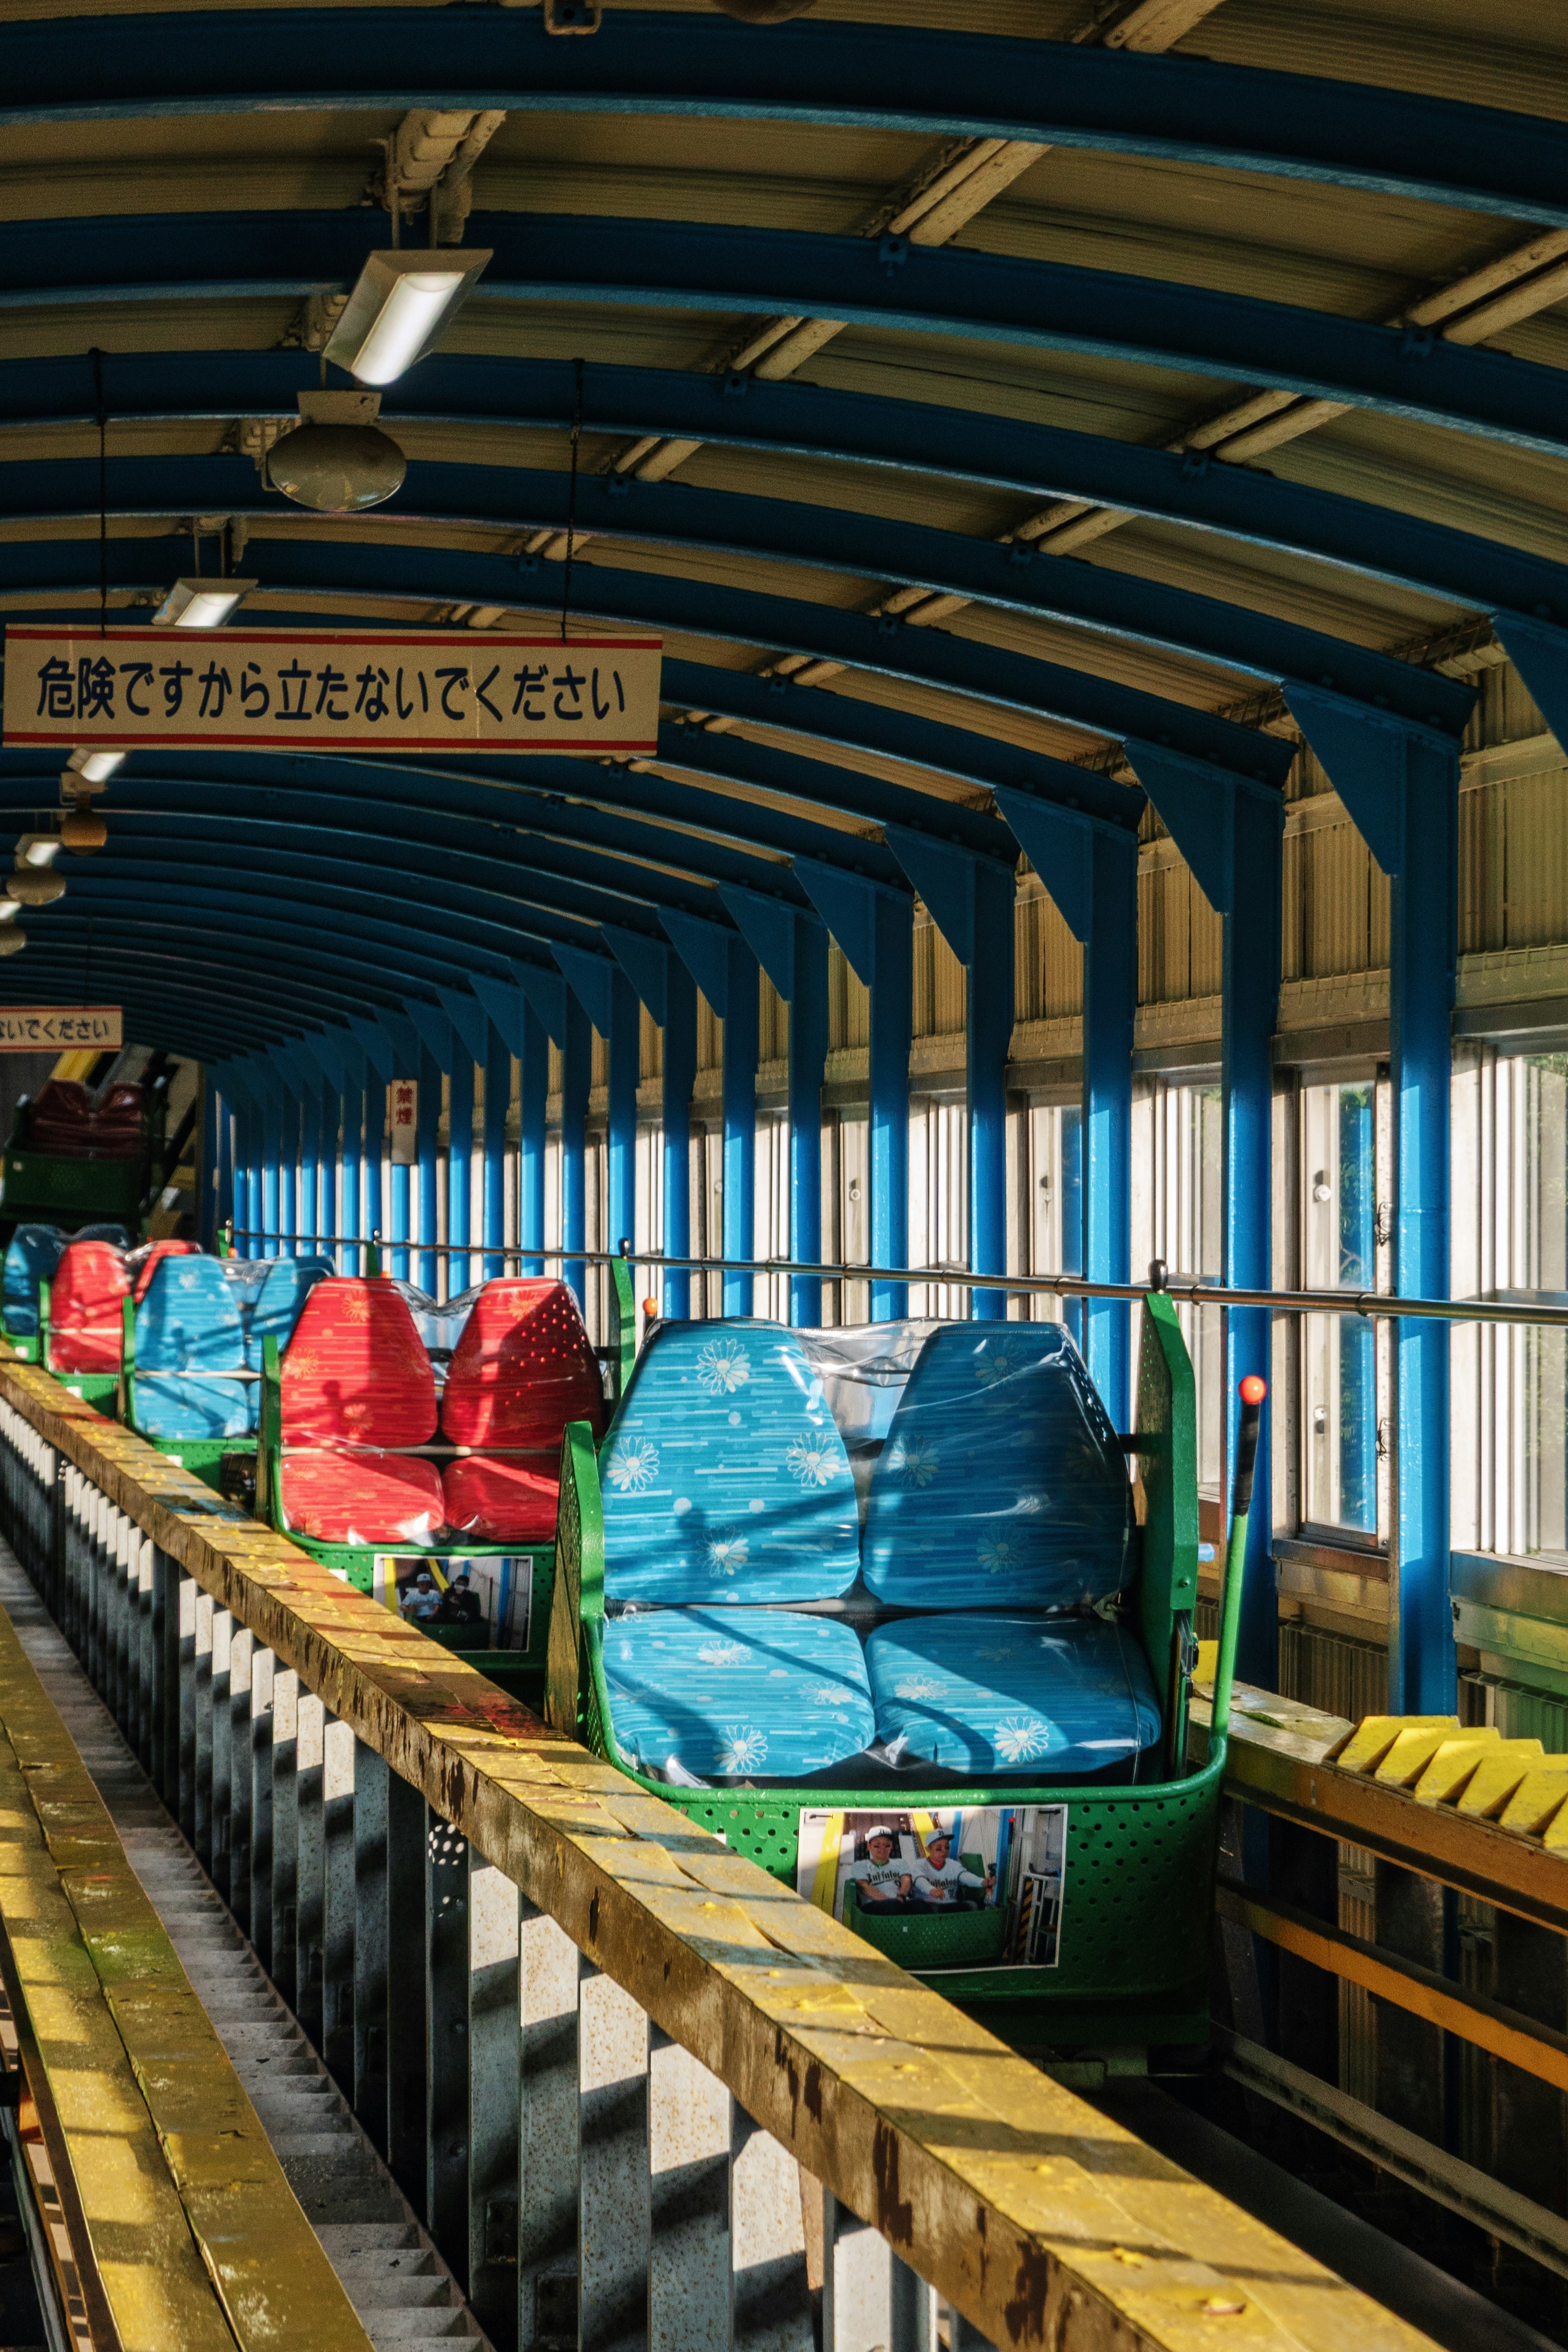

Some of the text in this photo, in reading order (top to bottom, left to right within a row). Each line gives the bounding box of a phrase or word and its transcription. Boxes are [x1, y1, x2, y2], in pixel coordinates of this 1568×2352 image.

[37, 656, 624, 722] 危険ですから立たないでください
[396, 1086, 413, 1125] 禁煙
